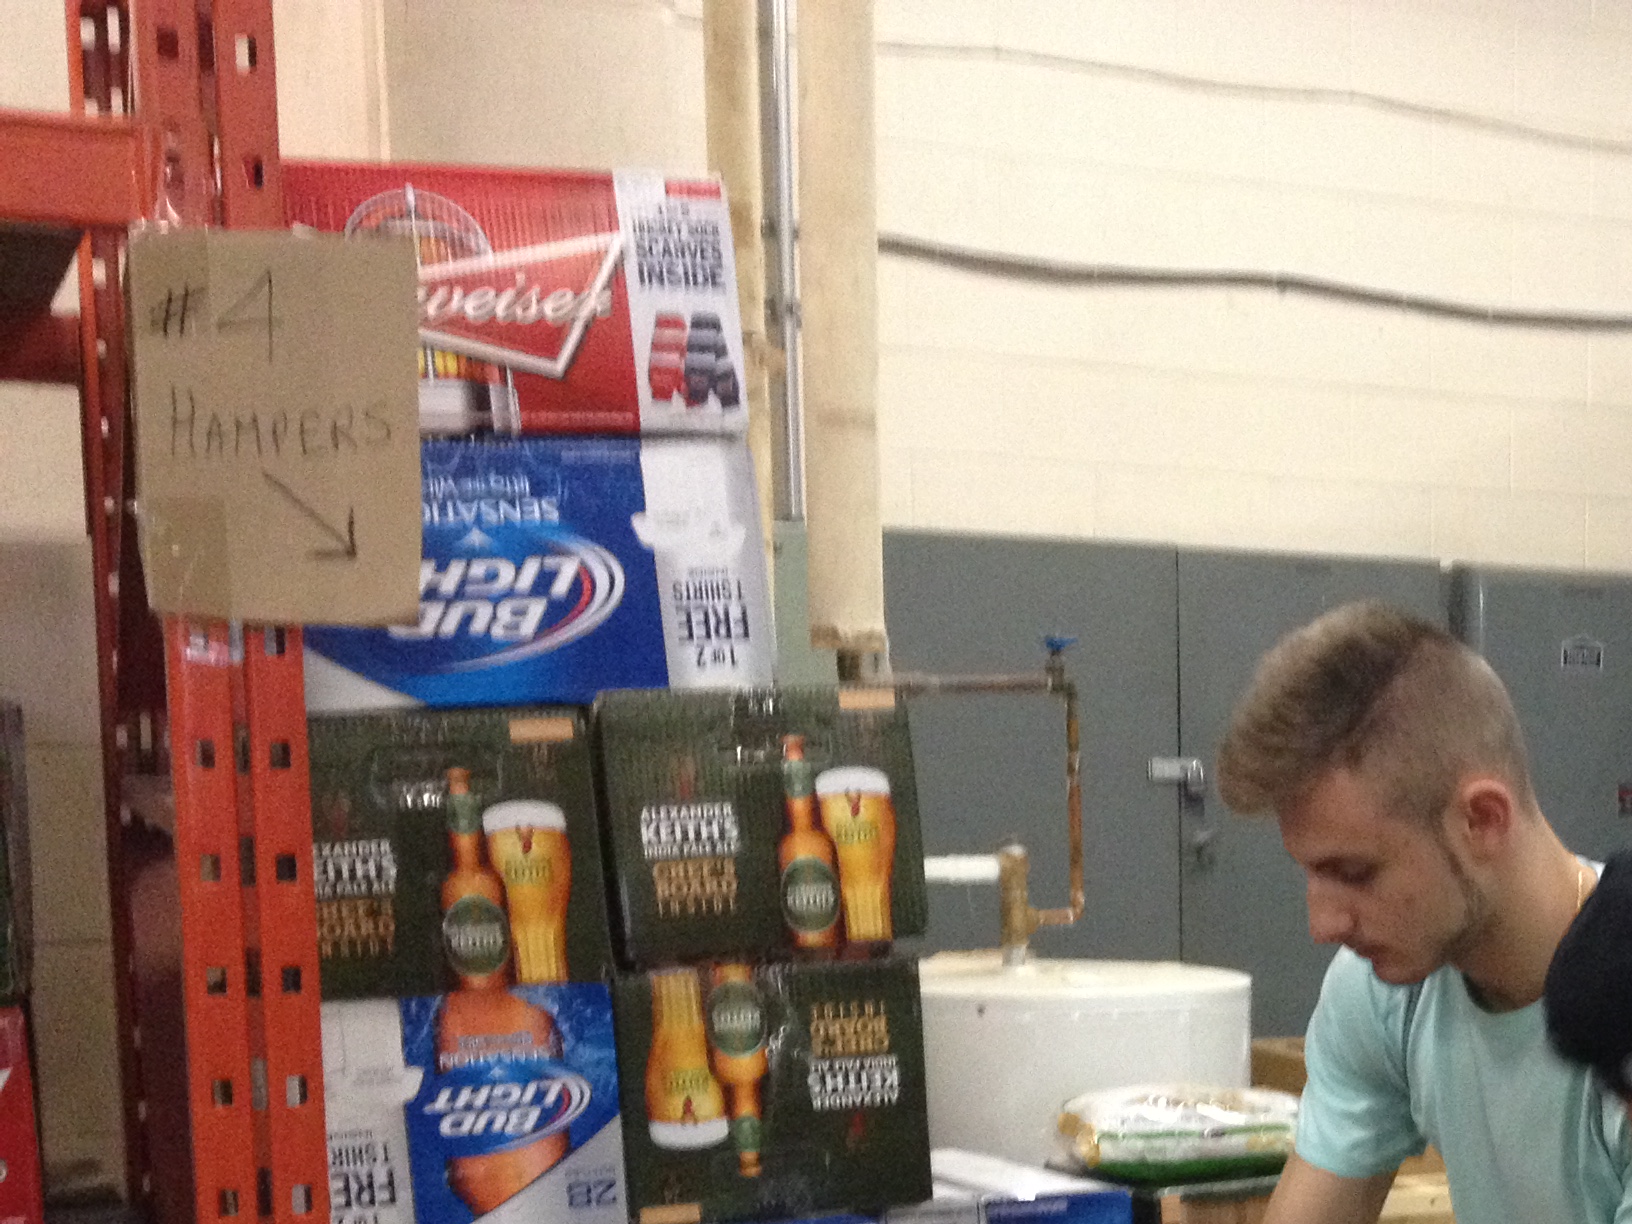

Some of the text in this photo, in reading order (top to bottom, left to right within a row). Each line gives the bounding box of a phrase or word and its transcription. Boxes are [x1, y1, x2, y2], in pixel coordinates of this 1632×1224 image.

[637, 259, 723, 289] INSIDE
[418, 264, 612, 328] weiser
[170, 385, 394, 459] HAMPERS
[422, 498, 561, 528] SENSATI
[419, 554, 581, 601] LIGH
[672, 579, 734, 603] SHIRTS
[674, 603, 750, 643] FREE
[696, 647, 707, 669] 2
[424, 1080, 562, 1116] LIGHT
[438, 1109, 542, 1138] BUD
[329, 1143, 378, 1169] SHIR
[329, 1168, 396, 1210] FRE
[565, 1178, 617, 1210] 28
